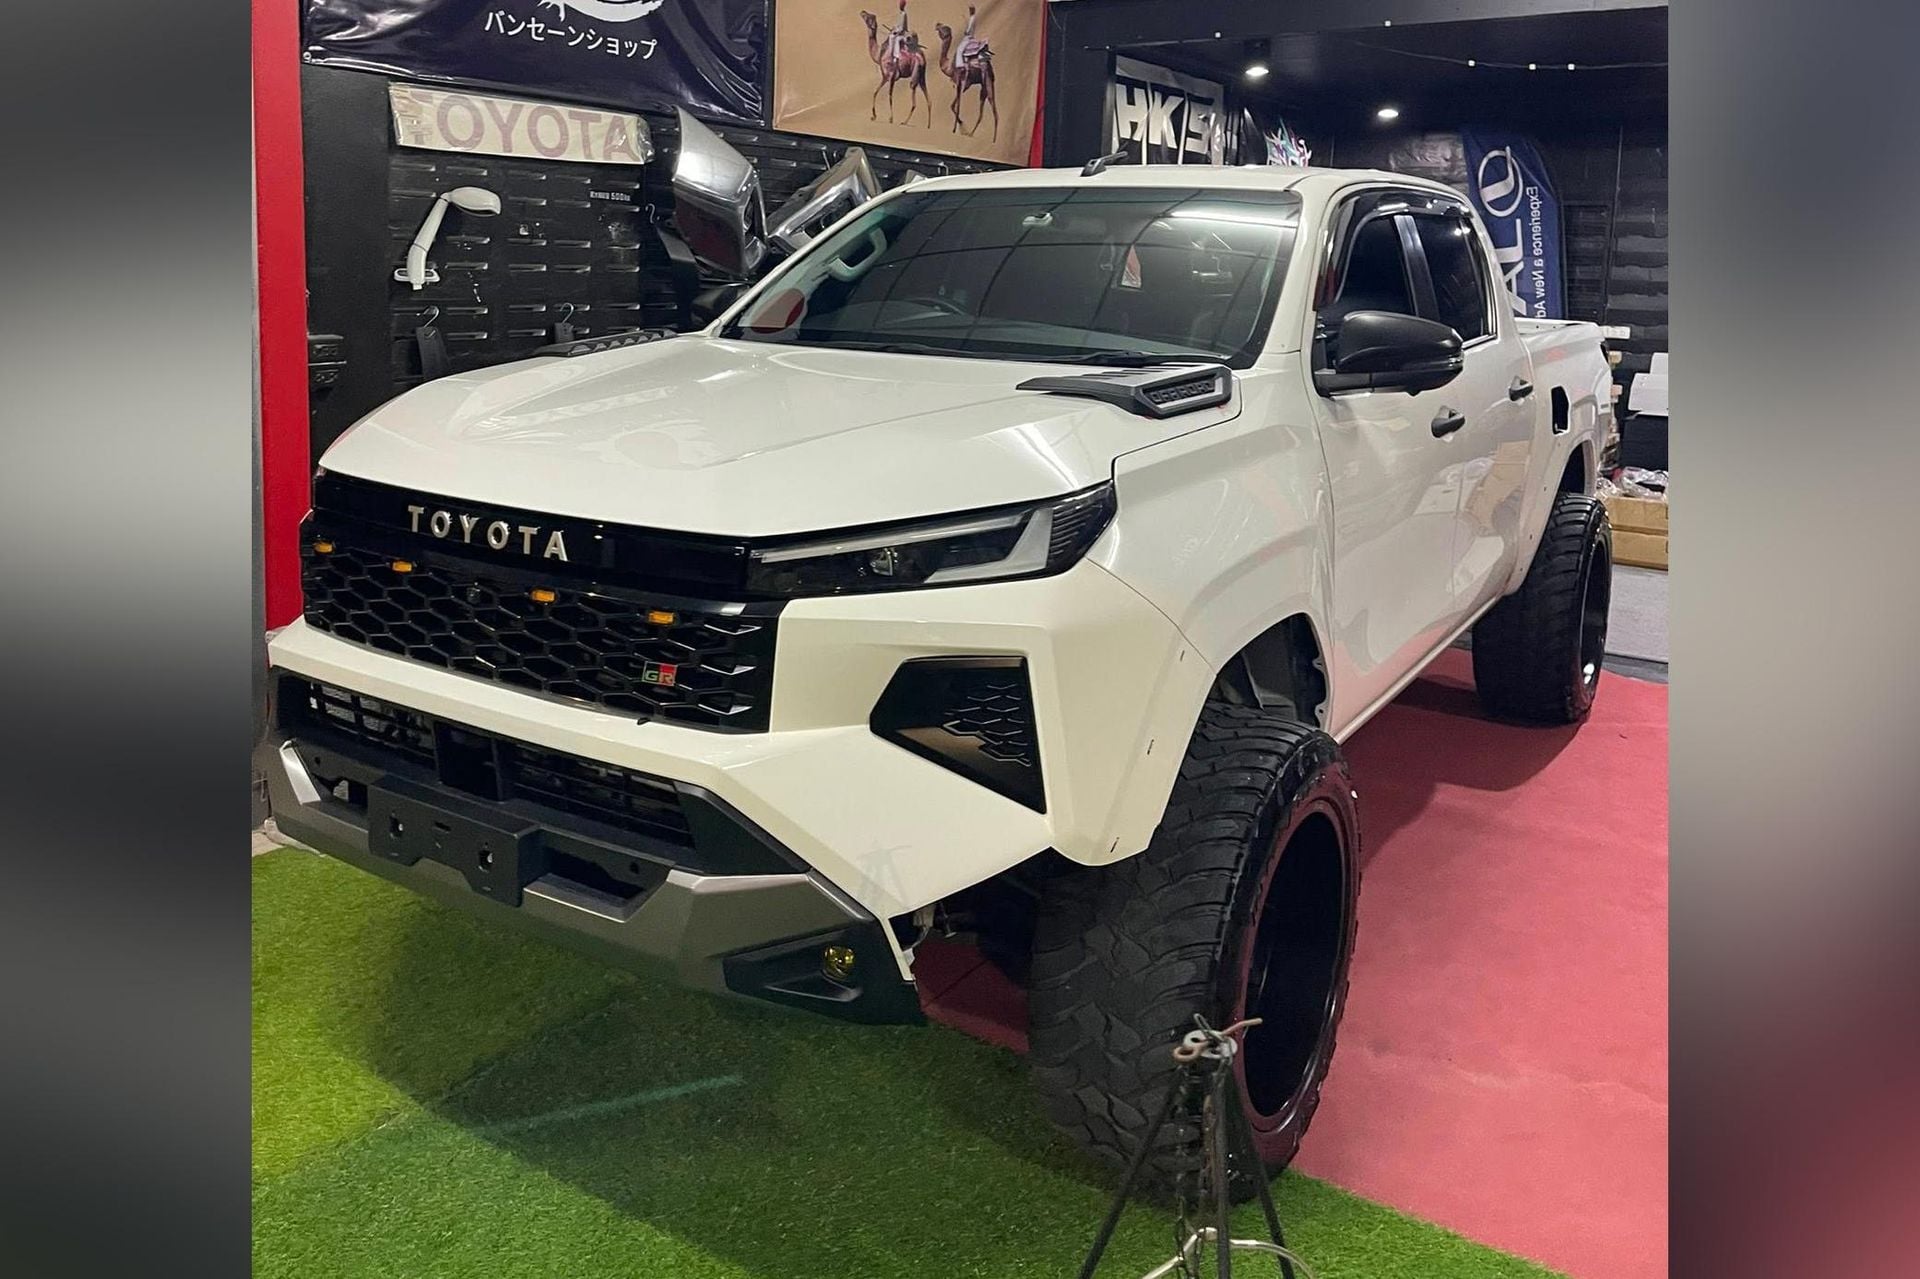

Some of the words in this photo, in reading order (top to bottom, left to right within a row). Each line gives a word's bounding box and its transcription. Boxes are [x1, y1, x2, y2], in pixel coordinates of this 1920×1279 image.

[484, 10, 658, 60] バンセーンショップ
[1114, 83, 1214, 155] HKS
[408, 505, 569, 562] TOYOTA
[645, 670, 674, 685] GR
